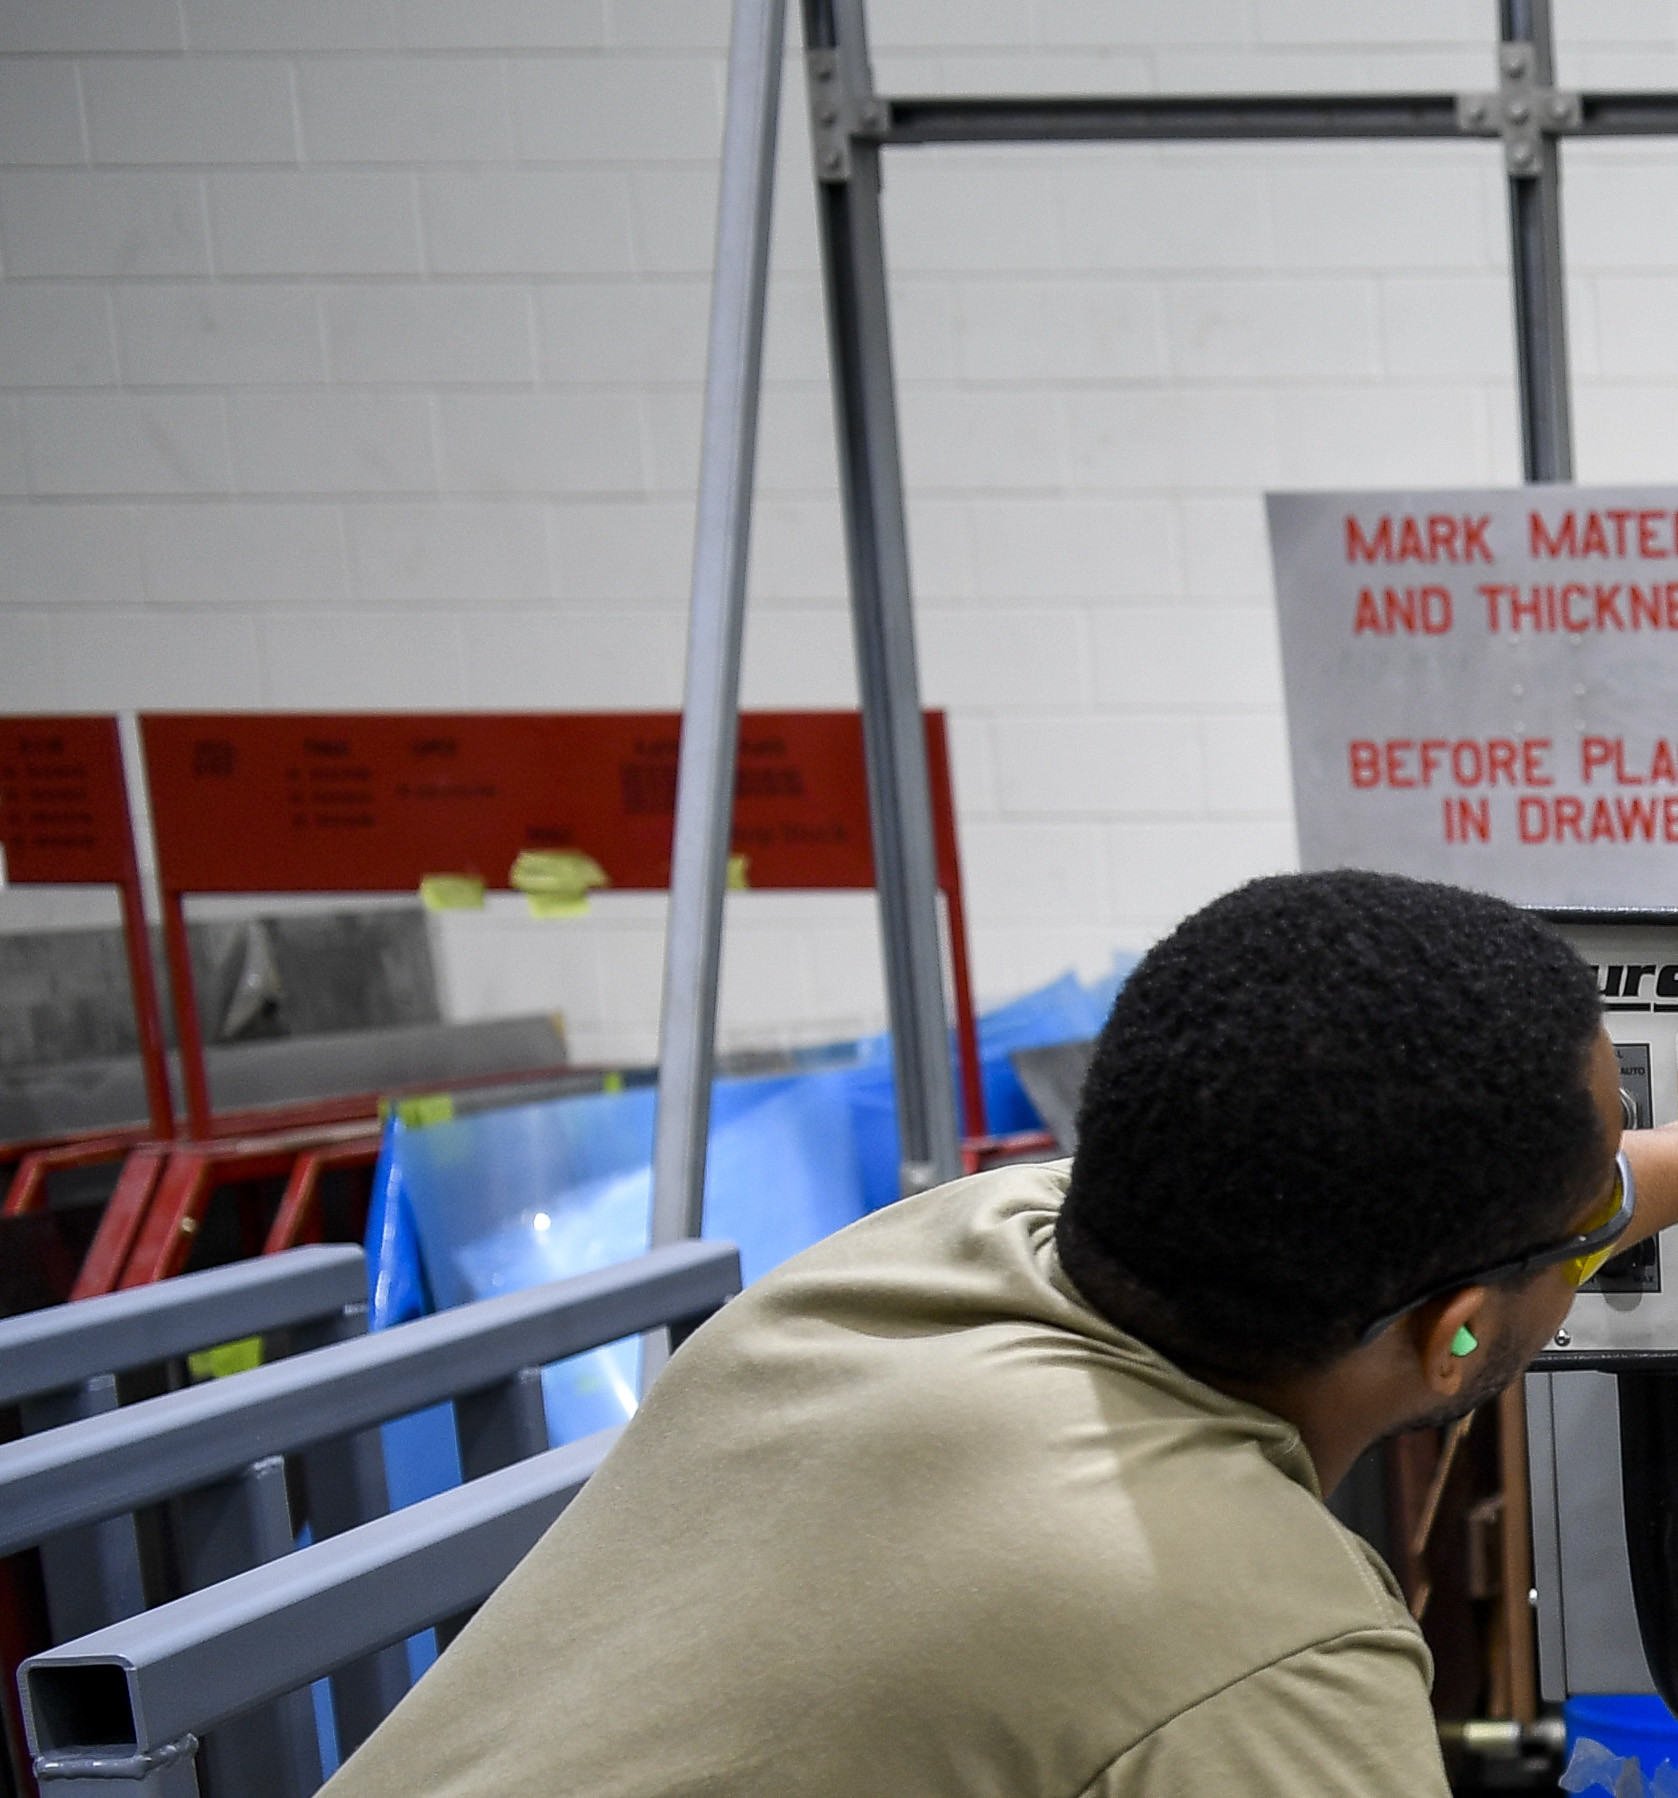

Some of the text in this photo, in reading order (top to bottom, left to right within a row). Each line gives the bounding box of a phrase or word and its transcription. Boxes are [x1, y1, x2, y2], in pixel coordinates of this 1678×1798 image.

[1345, 513, 1493, 564] MARK
[1353, 585, 1452, 636] AND
[1348, 738, 1554, 789] BEFORE
[1441, 796, 1492, 844] IN
